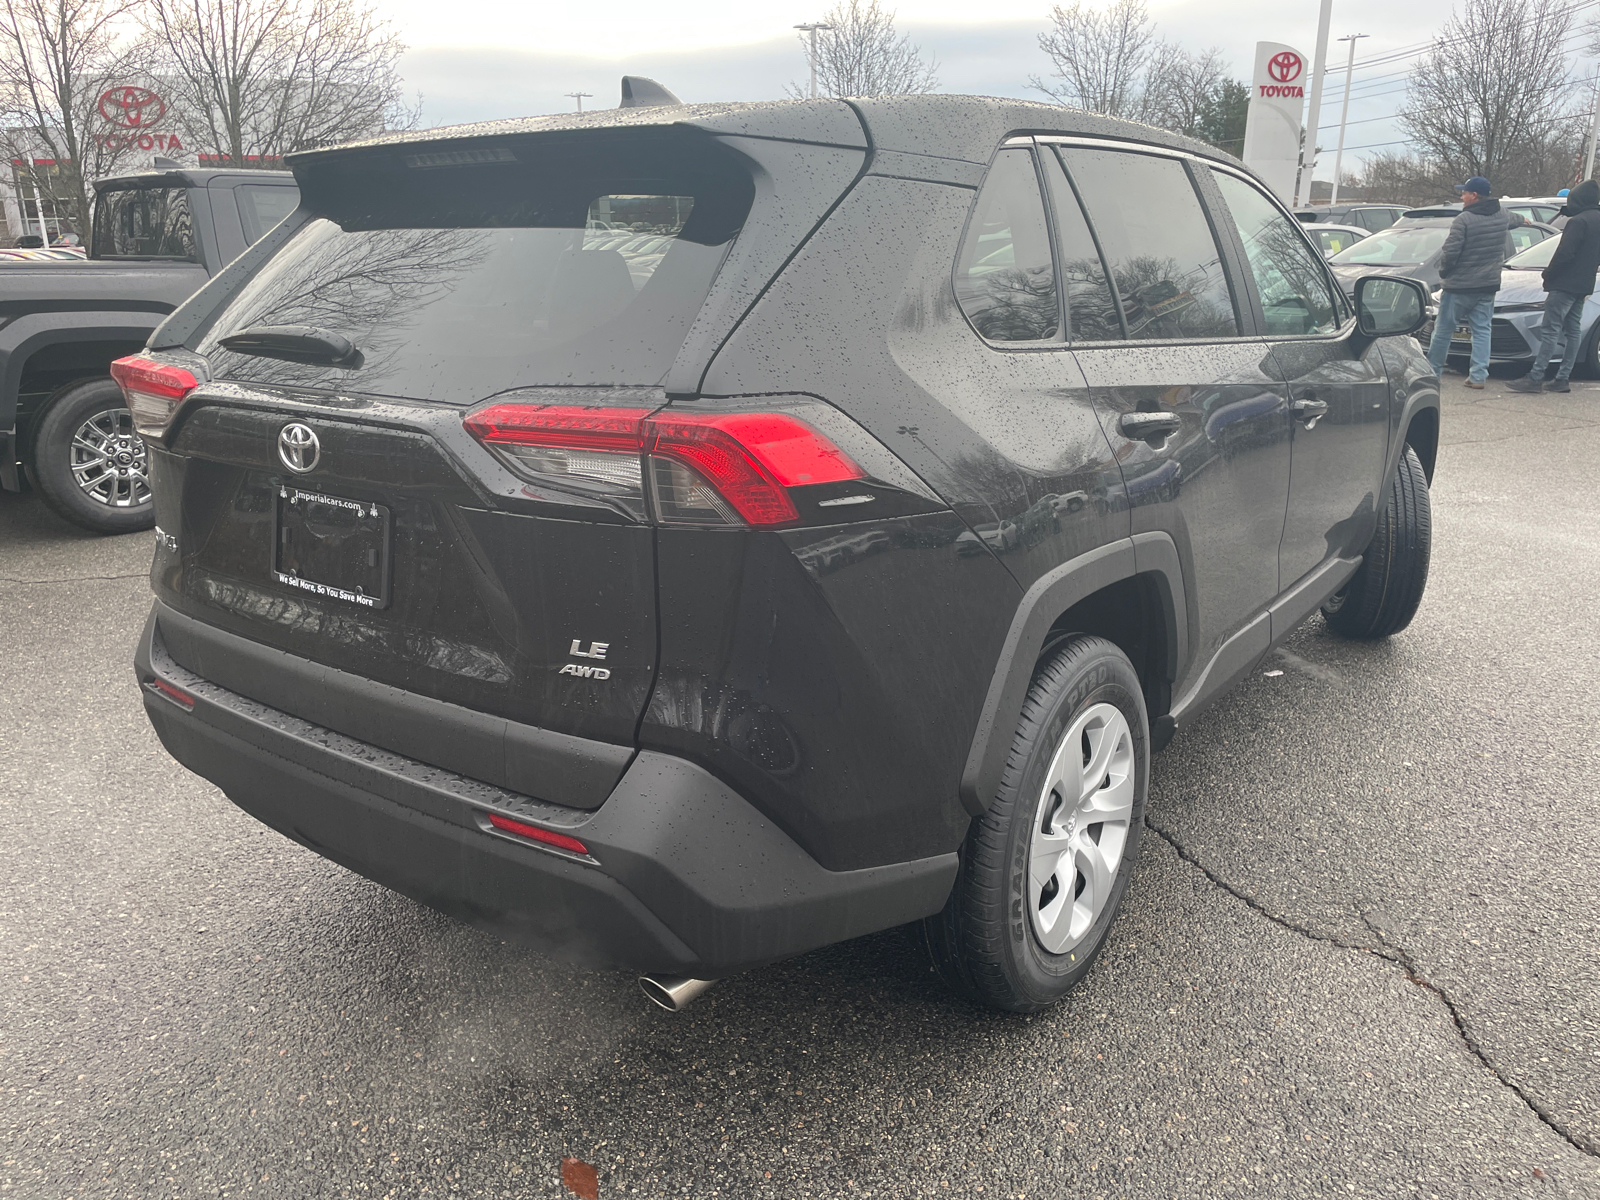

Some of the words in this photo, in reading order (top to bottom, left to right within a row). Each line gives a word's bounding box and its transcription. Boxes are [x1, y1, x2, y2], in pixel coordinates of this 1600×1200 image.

[1259, 85, 1304, 98] TOYOTA
[295, 489, 361, 511] Imperialcars.com
[279, 574, 288, 583] We
[288, 577, 299, 587] Sell
[299, 580, 316, 593] More,
[317, 585, 325, 594] So
[326, 587, 338, 598] You
[340, 591, 355, 602] Save
[356, 595, 373, 607] More
[569, 639, 610, 660] LE
[558, 664, 611, 680] AWD
